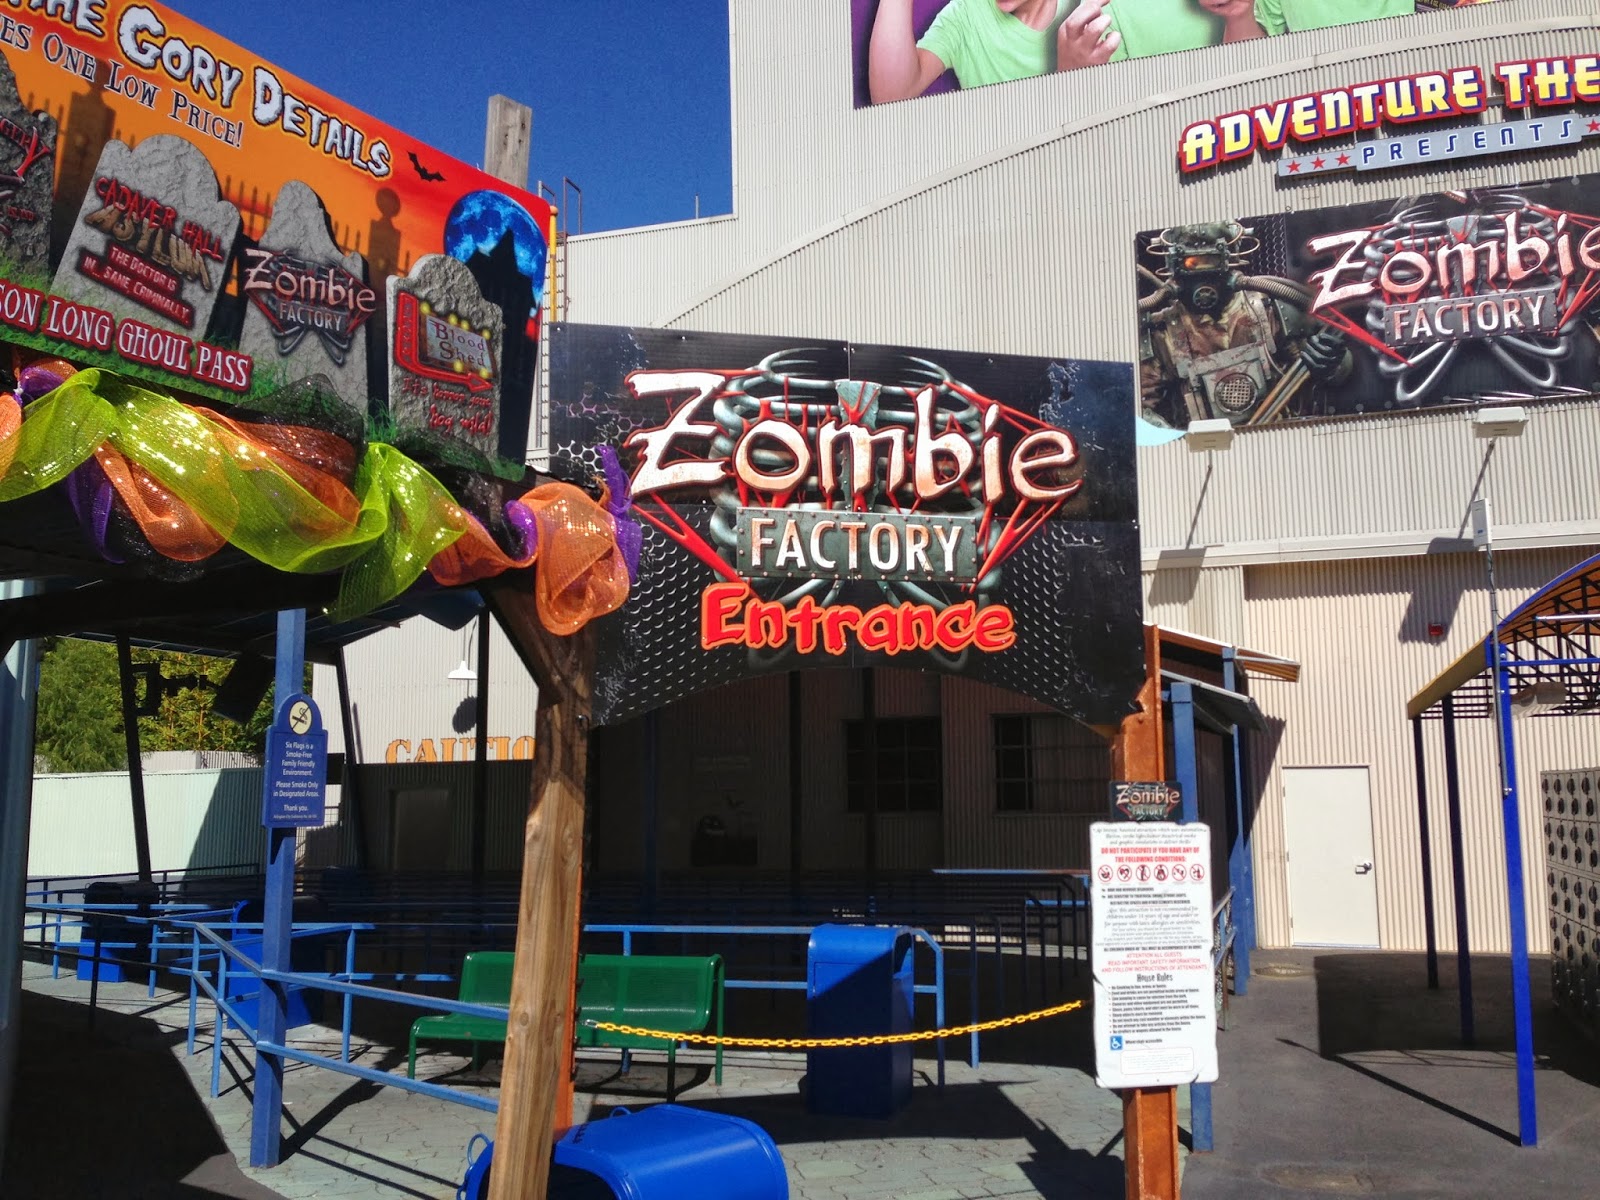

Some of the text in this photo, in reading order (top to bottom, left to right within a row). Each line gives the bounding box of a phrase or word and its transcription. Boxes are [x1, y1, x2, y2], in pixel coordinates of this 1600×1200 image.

[30, 0, 393, 177] HE GORY DETAILS
[43, 33, 96, 82] ONE
[106, 60, 160, 109] LOW
[169, 88, 243, 149] PRICE!
[1180, 57, 1600, 171] ADVENTURE THE
[1362, 119, 1573, 165] PRESENTS
[96, 176, 224, 263] CADAVER HALL
[110, 246, 177, 291] THE DOCTOR IS
[244, 248, 377, 313] Zombie
[1307, 210, 1600, 315] Zombie
[279, 301, 343, 333] FACTORY
[430, 319, 486, 351] Blood
[1393, 294, 1546, 341] FACTORY
[47, 299, 111, 347] LONG
[118, 321, 190, 371] GHOUL
[196, 345, 250, 387] PASS
[439, 341, 486, 366] Shed
[430, 404, 454, 434] hog
[624, 369, 1083, 501] Zombie
[749, 517, 962, 573] FACTORY
[701, 582, 1017, 656] Entrance
[282, 760, 315, 768] Family Friendly
[293, 742, 304, 750] Flags
[1116, 785, 1180, 805] Zombie
[1132, 807, 1162, 816] FACTORY
[1137, 972, 1173, 982] House Rules
